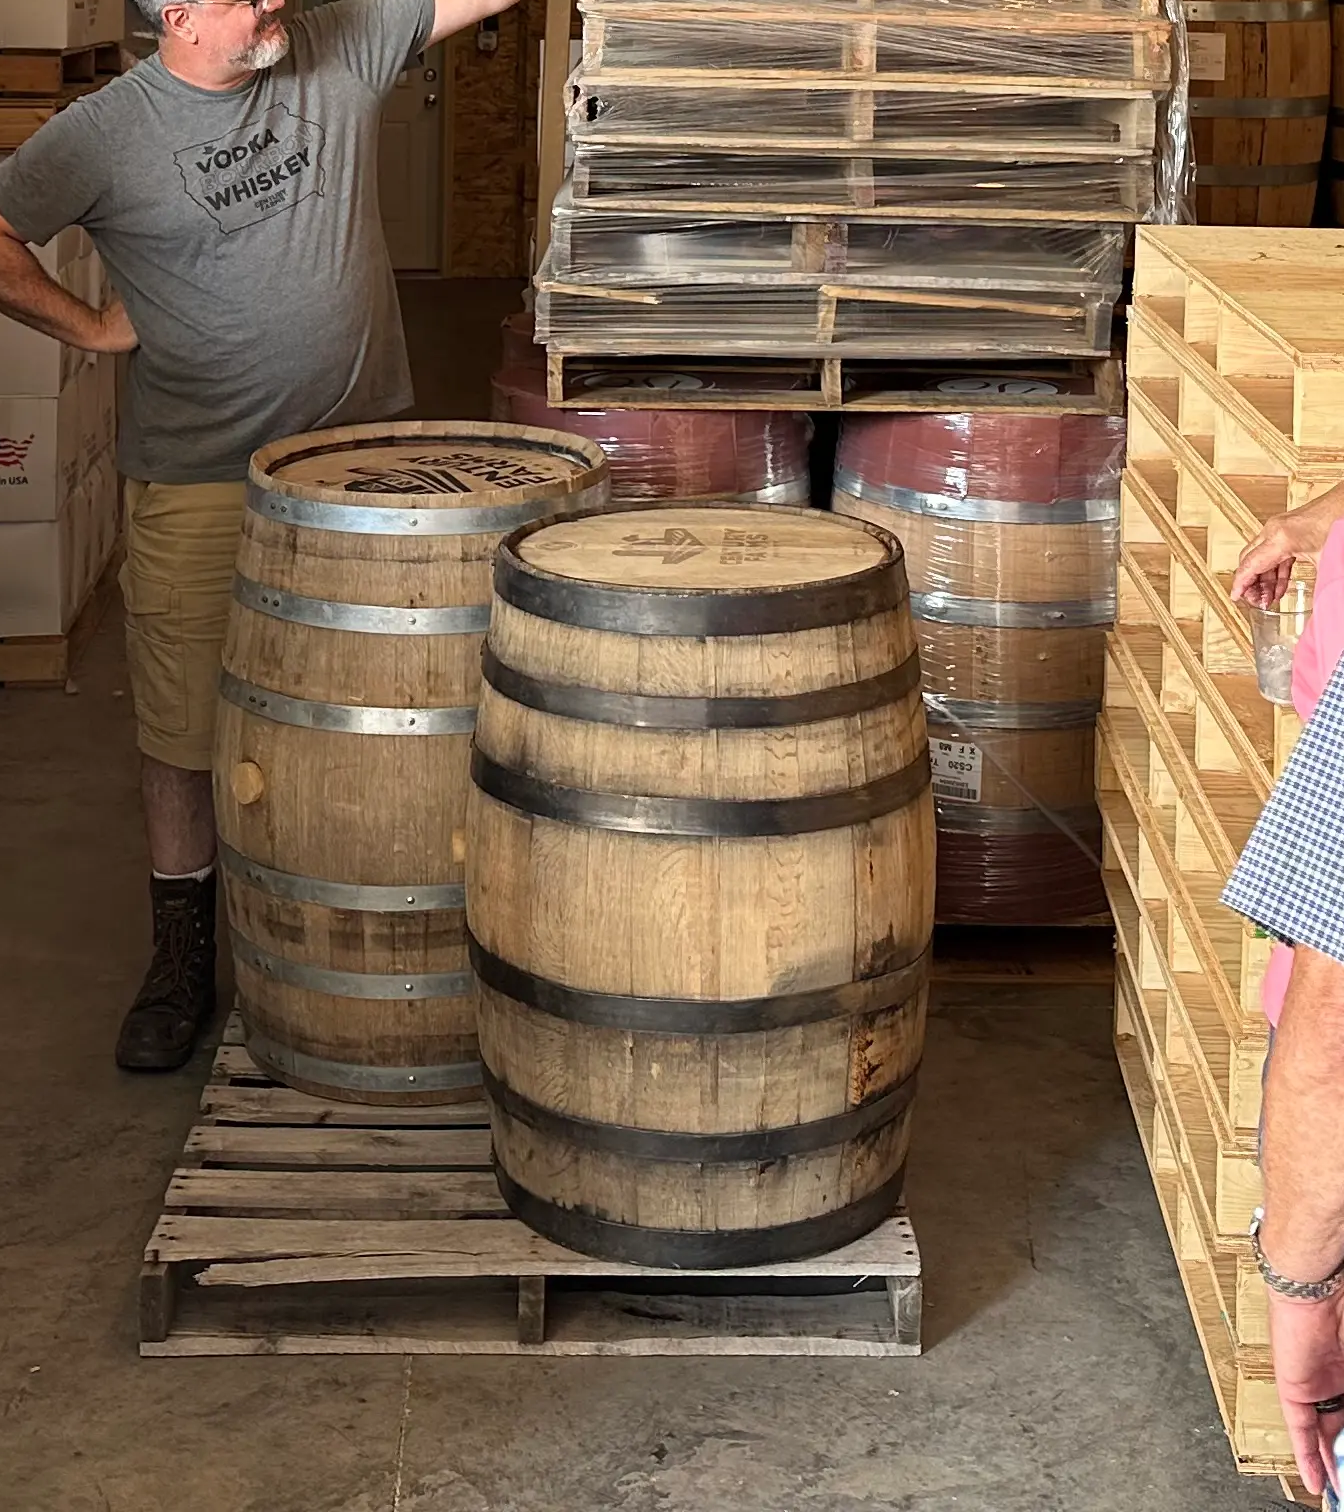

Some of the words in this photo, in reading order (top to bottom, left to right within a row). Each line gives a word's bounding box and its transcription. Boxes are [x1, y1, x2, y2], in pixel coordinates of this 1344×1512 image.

[195, 128, 280, 174] VODKA
[199, 126, 314, 194] BOURBON
[204, 147, 312, 211] WHISKEY
[8, 476, 29, 485] USA
[397, 455, 523, 489] ENTURY
[948, 760, 973, 772] CS20
